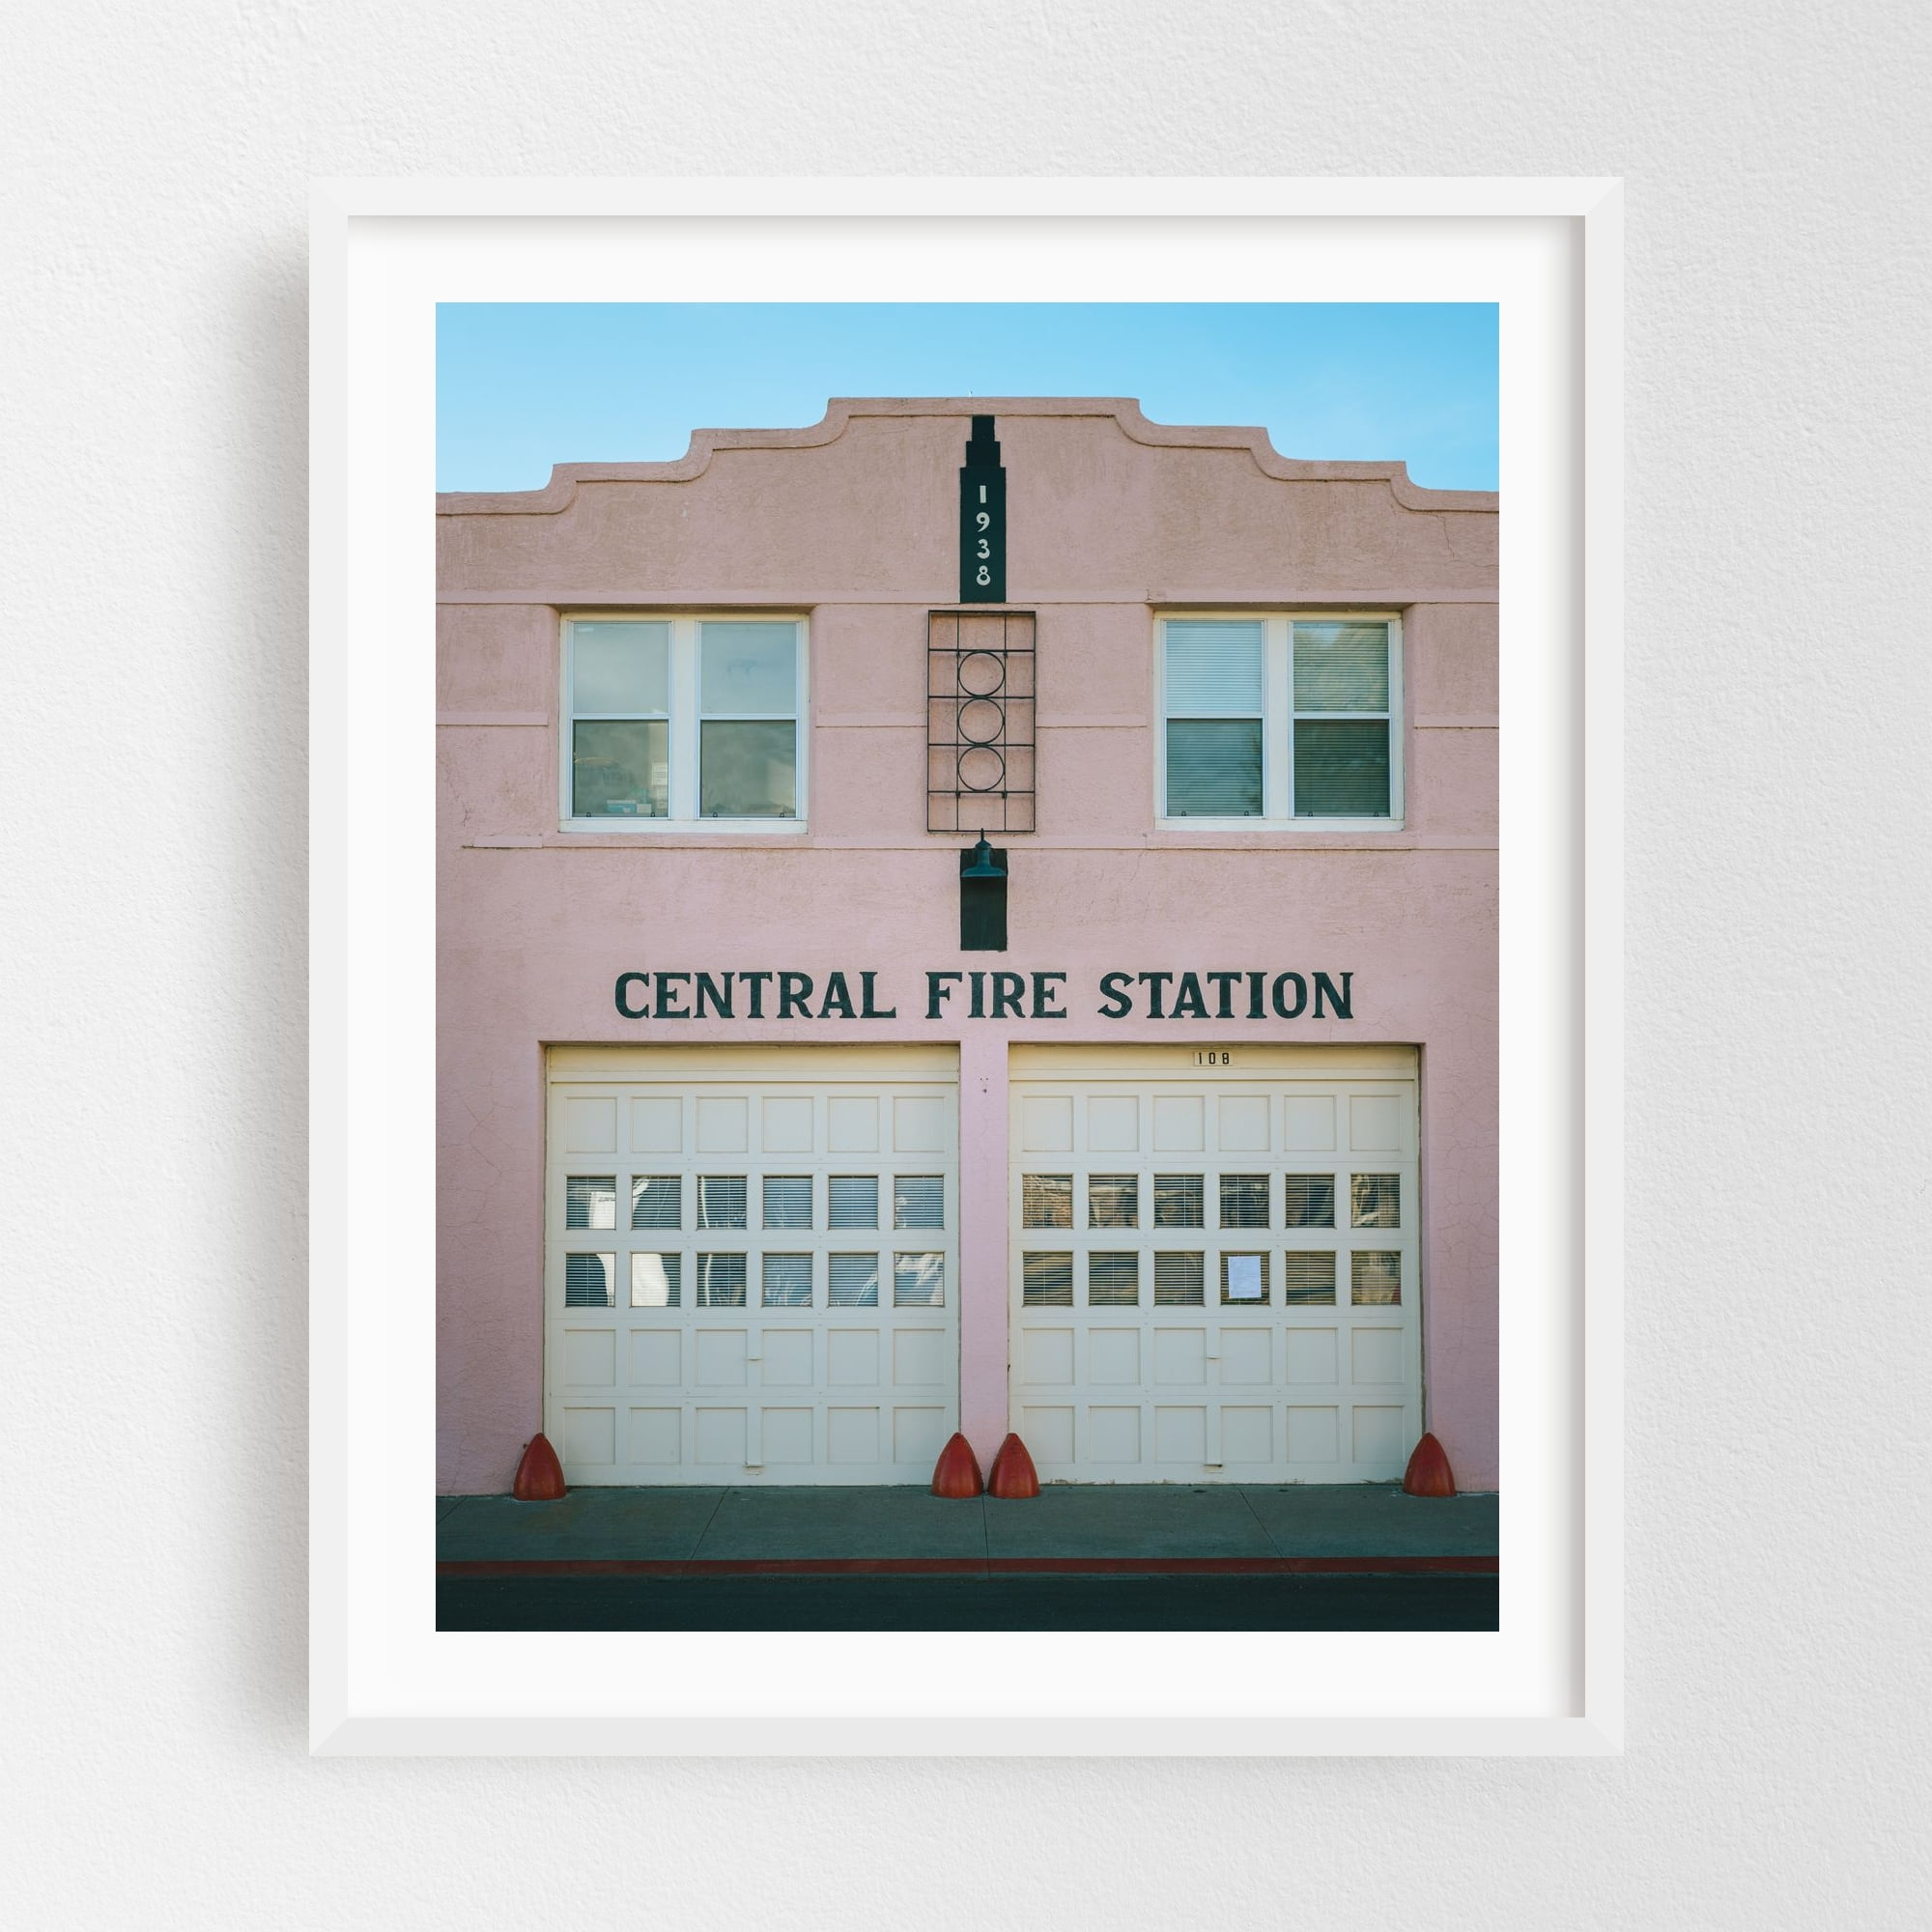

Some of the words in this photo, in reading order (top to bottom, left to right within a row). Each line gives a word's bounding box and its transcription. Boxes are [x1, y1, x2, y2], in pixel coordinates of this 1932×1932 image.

[976, 485, 991, 586] 1938
[614, 971, 897, 1020] CENTRAL
[924, 971, 1067, 1020] FIRE
[1097, 971, 1354, 1020] STATION
[1198, 1052, 1230, 1065] 108
